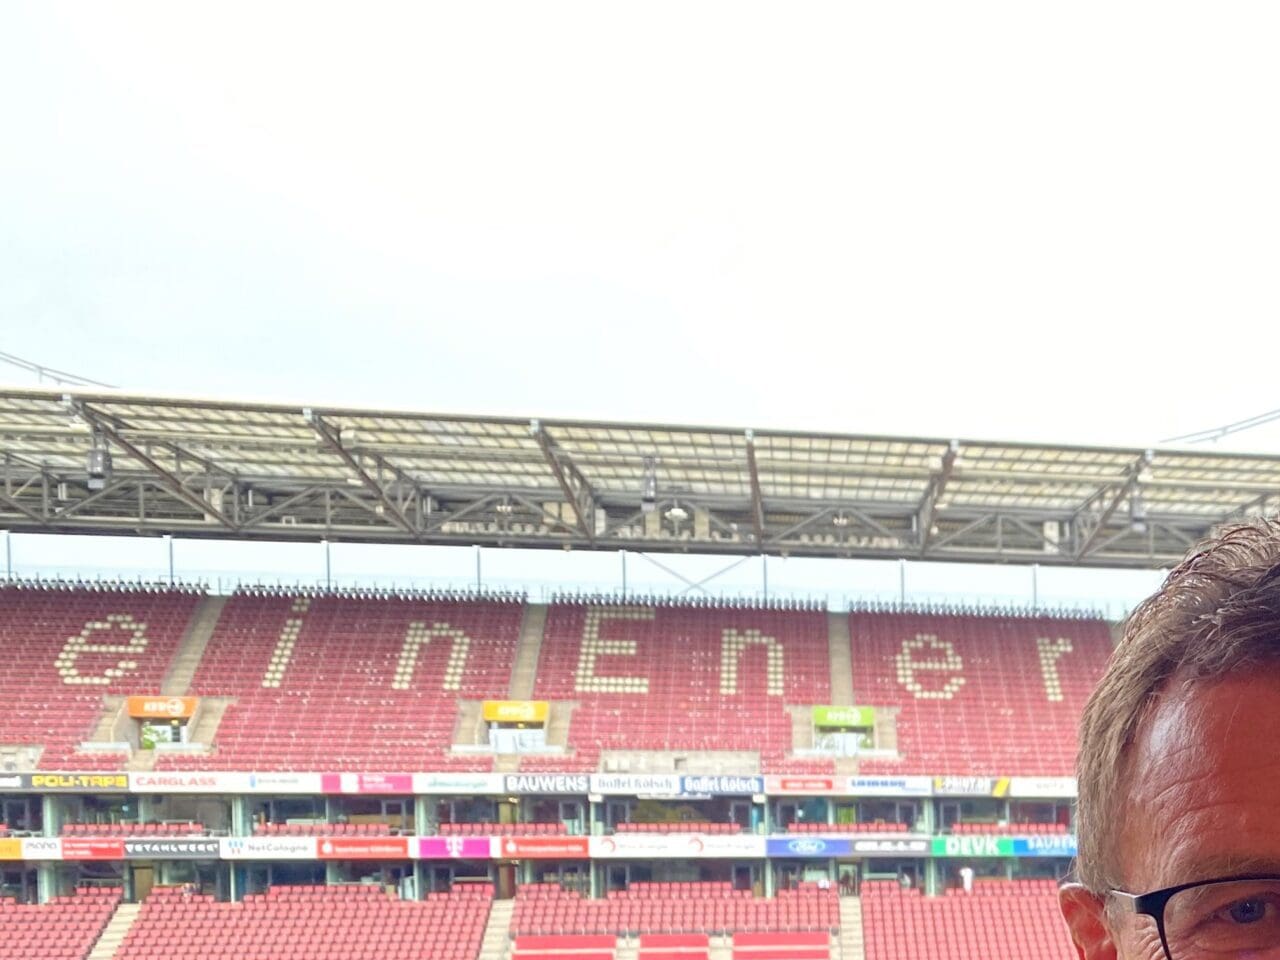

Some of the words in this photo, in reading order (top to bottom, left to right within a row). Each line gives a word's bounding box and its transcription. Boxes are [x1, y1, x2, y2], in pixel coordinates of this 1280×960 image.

[507, 776, 588, 792] BAUWENS
[249, 843, 309, 854] NetCologne
[946, 838, 999, 855] DEVK
